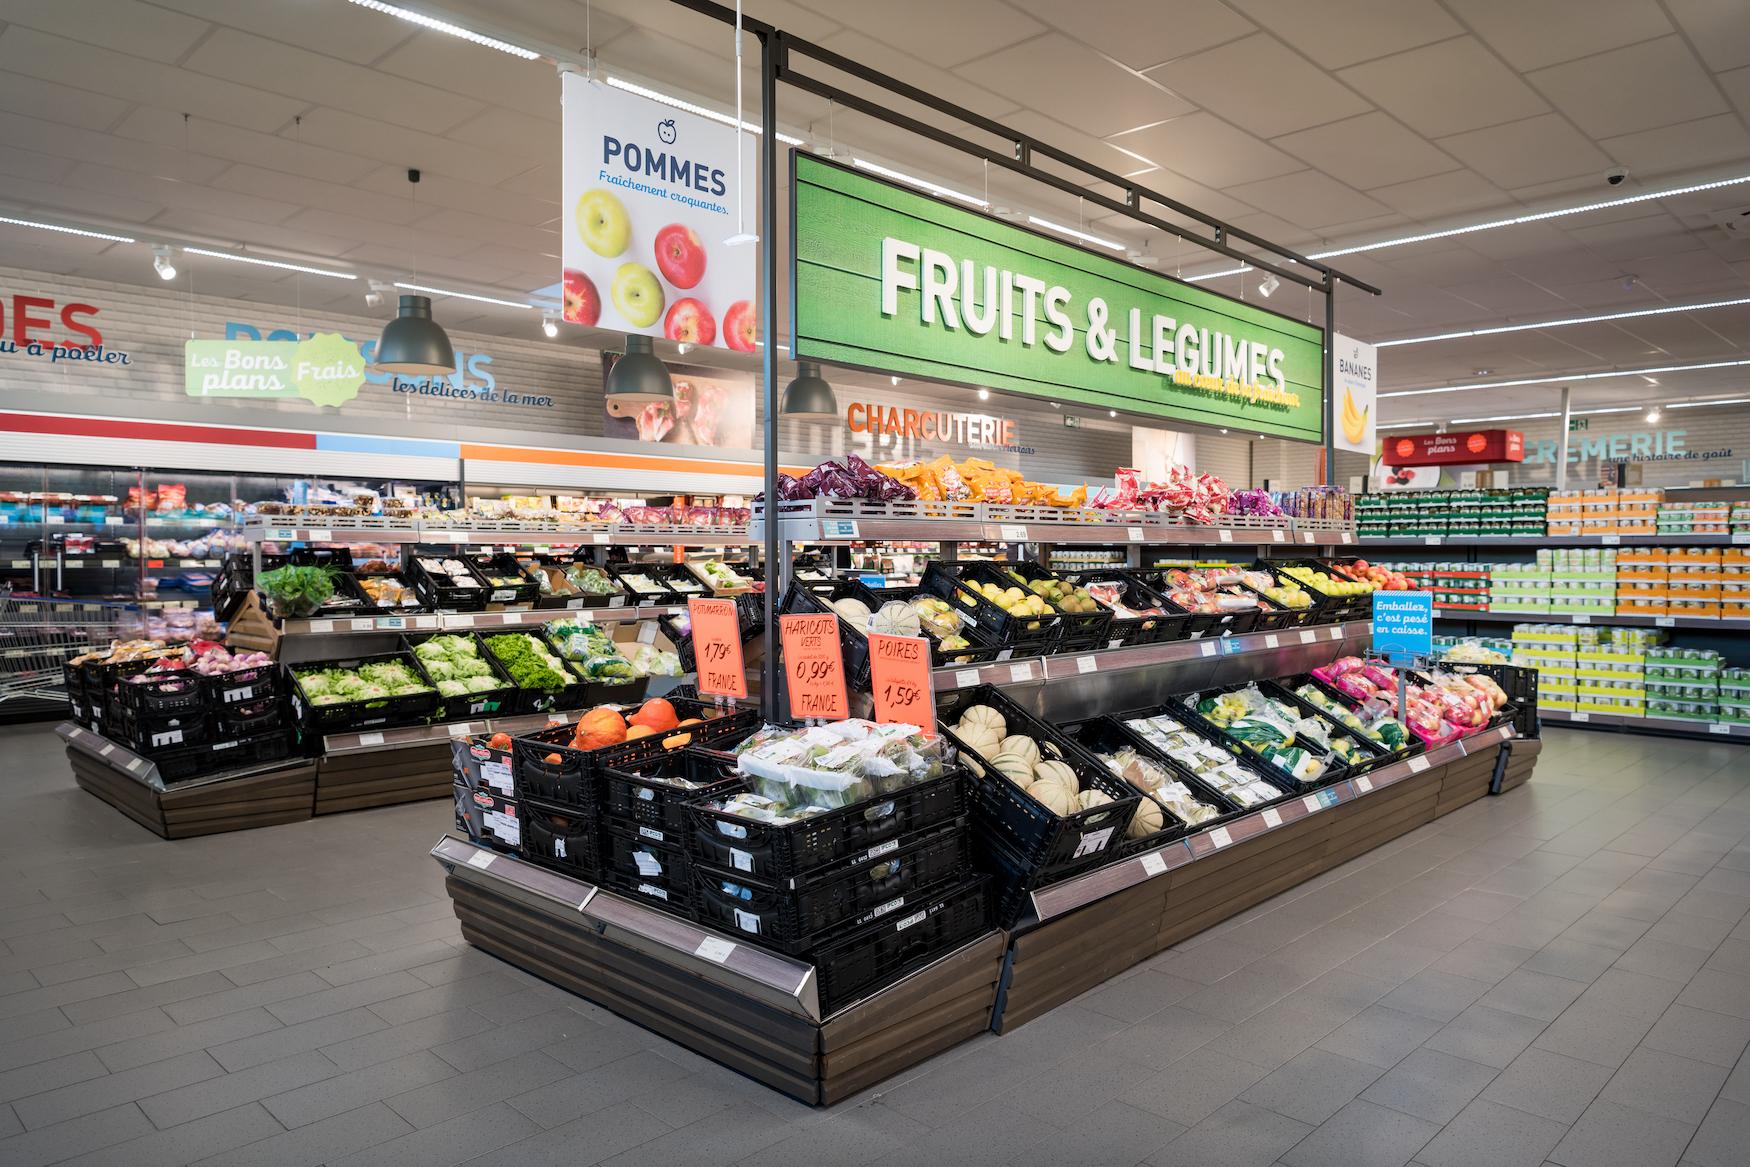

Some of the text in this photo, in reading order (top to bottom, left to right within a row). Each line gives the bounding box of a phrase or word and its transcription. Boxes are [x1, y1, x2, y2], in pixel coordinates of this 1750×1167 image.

[603, 135, 726, 196] POMMES
[598, 169, 729, 215] Fraîchement croquantes.
[0, 294, 103, 351] ES
[881, 236, 1286, 392] FRUITS & LEGUMES
[27, 339, 45, 356] à
[52, 345, 132, 364] poêler
[191, 349, 288, 370] Les Bons
[297, 360, 360, 381] Frais
[1340, 358, 1372, 381] BANANES
[201, 370, 285, 396] plans
[392, 377, 417, 393] les
[480, 387, 498, 402] de
[502, 389, 519, 404] la
[522, 395, 554, 407] mer
[847, 402, 1017, 446] CHARCUTERIE
[1427, 445, 1456, 456] plans
[1632, 450, 1682, 462] histoire
[1684, 450, 1700, 460] de
[1702, 447, 1733, 462] goût
[1376, 600, 1428, 613] Emballez,
[785, 619, 835, 636] HARICOTS
[1402, 613, 1428, 625] pesé
[1376, 625, 1428, 635] en caisse.
[800, 636, 822, 647] VERTS
[878, 640, 919, 660] POIRES
[707, 672, 737, 691] FRANCE
[796, 660, 836, 684] 0,99€
[801, 693, 837, 713] FRANCE
